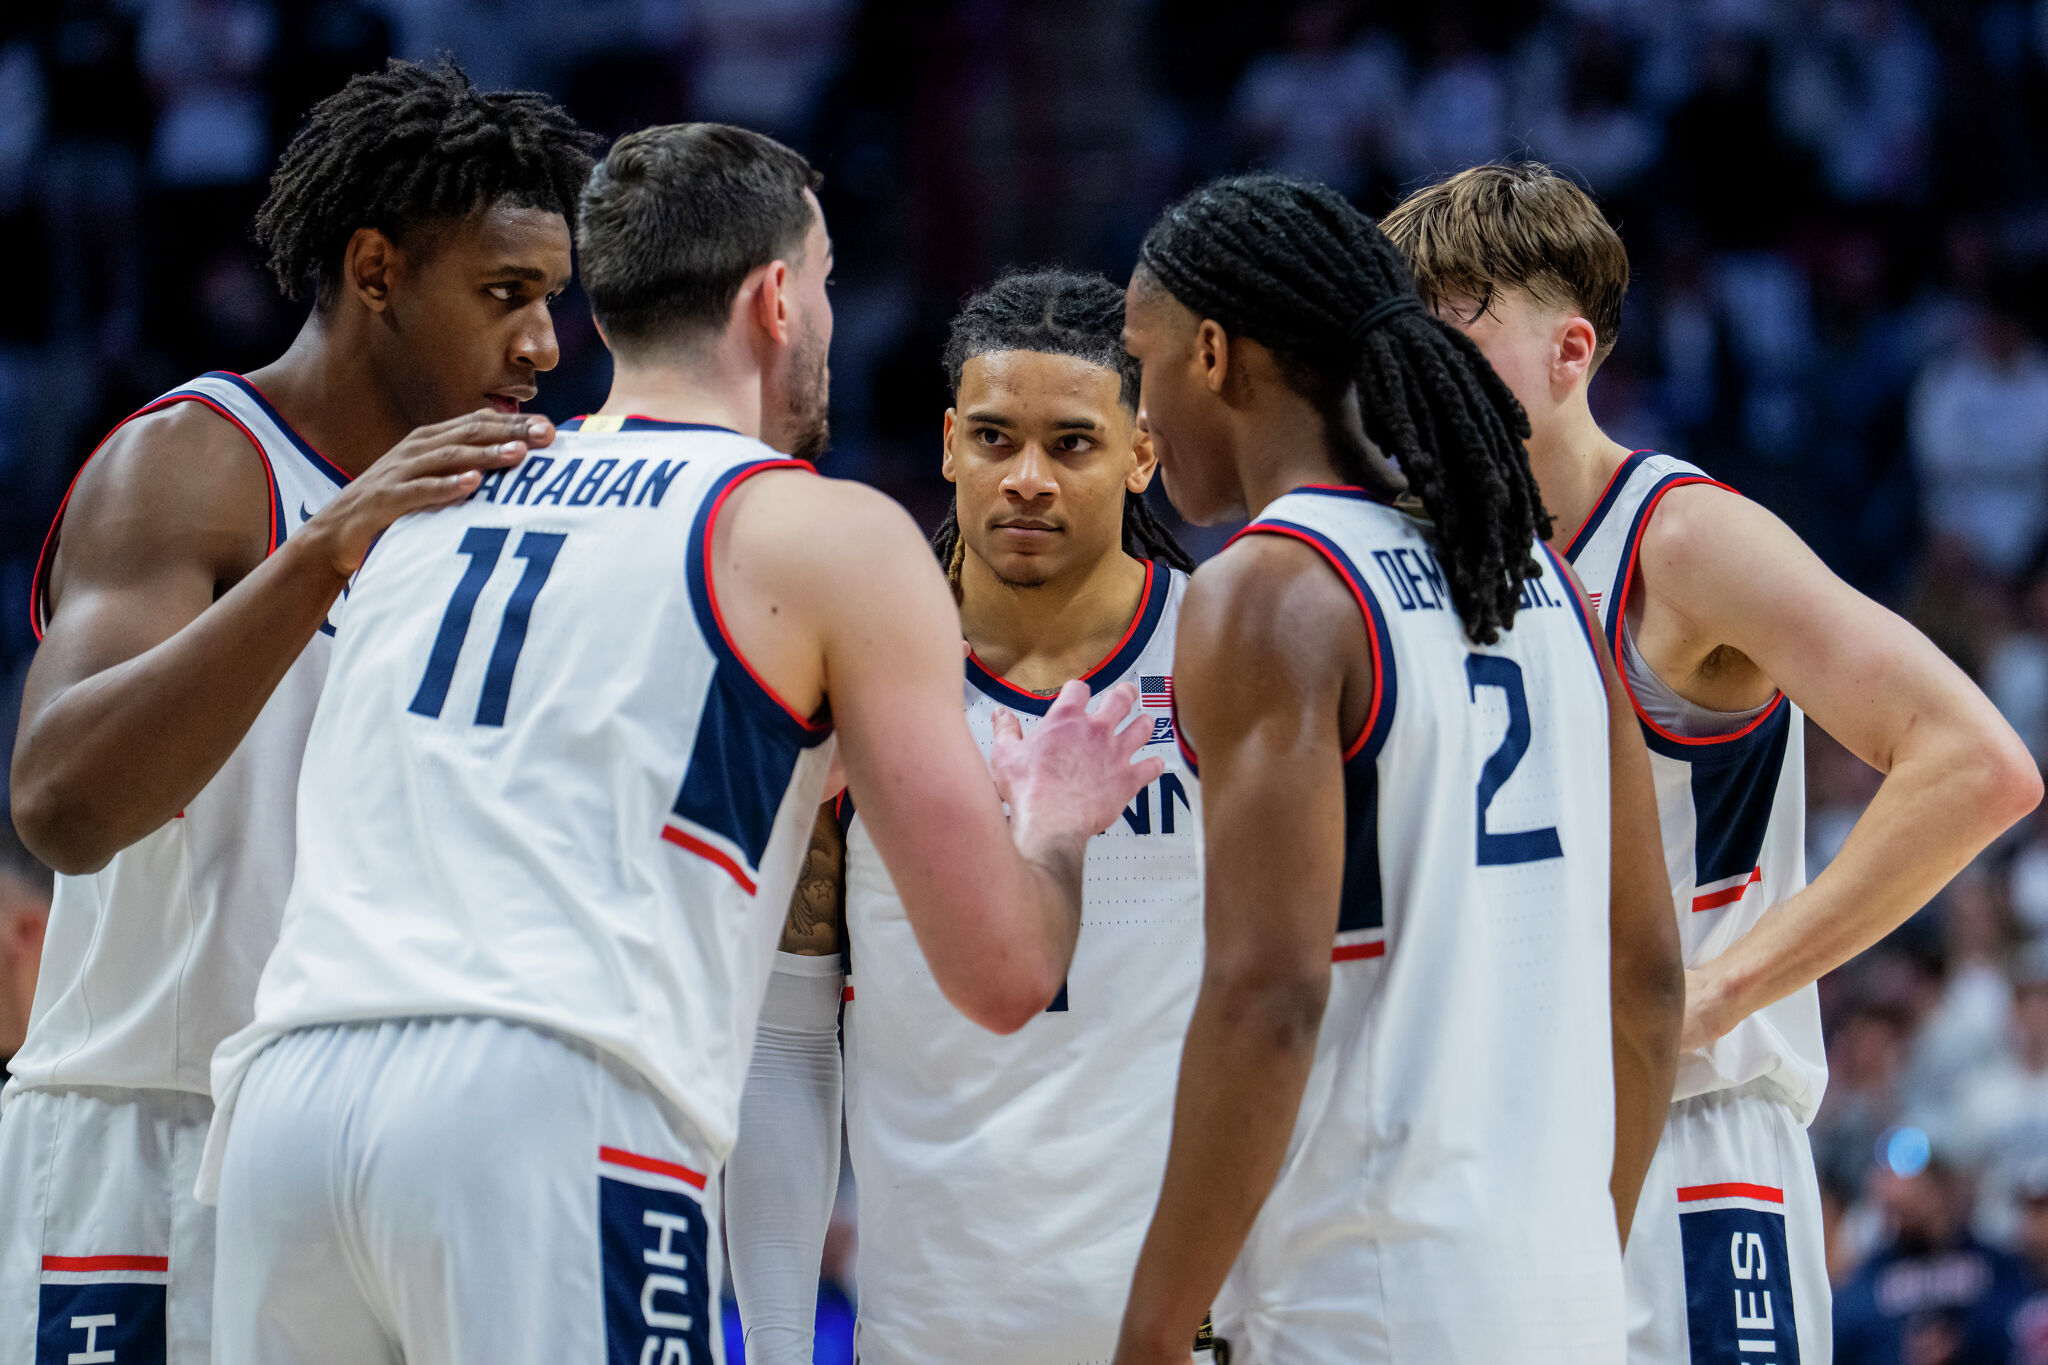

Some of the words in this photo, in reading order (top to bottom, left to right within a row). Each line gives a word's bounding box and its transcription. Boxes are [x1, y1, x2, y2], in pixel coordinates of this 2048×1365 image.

[466, 456, 689, 507] ARABAN
[408, 527, 567, 727] 11
[1371, 549, 1447, 611] DEM
[1465, 653, 1565, 866] 2
[1731, 1231, 1777, 1365] IES
